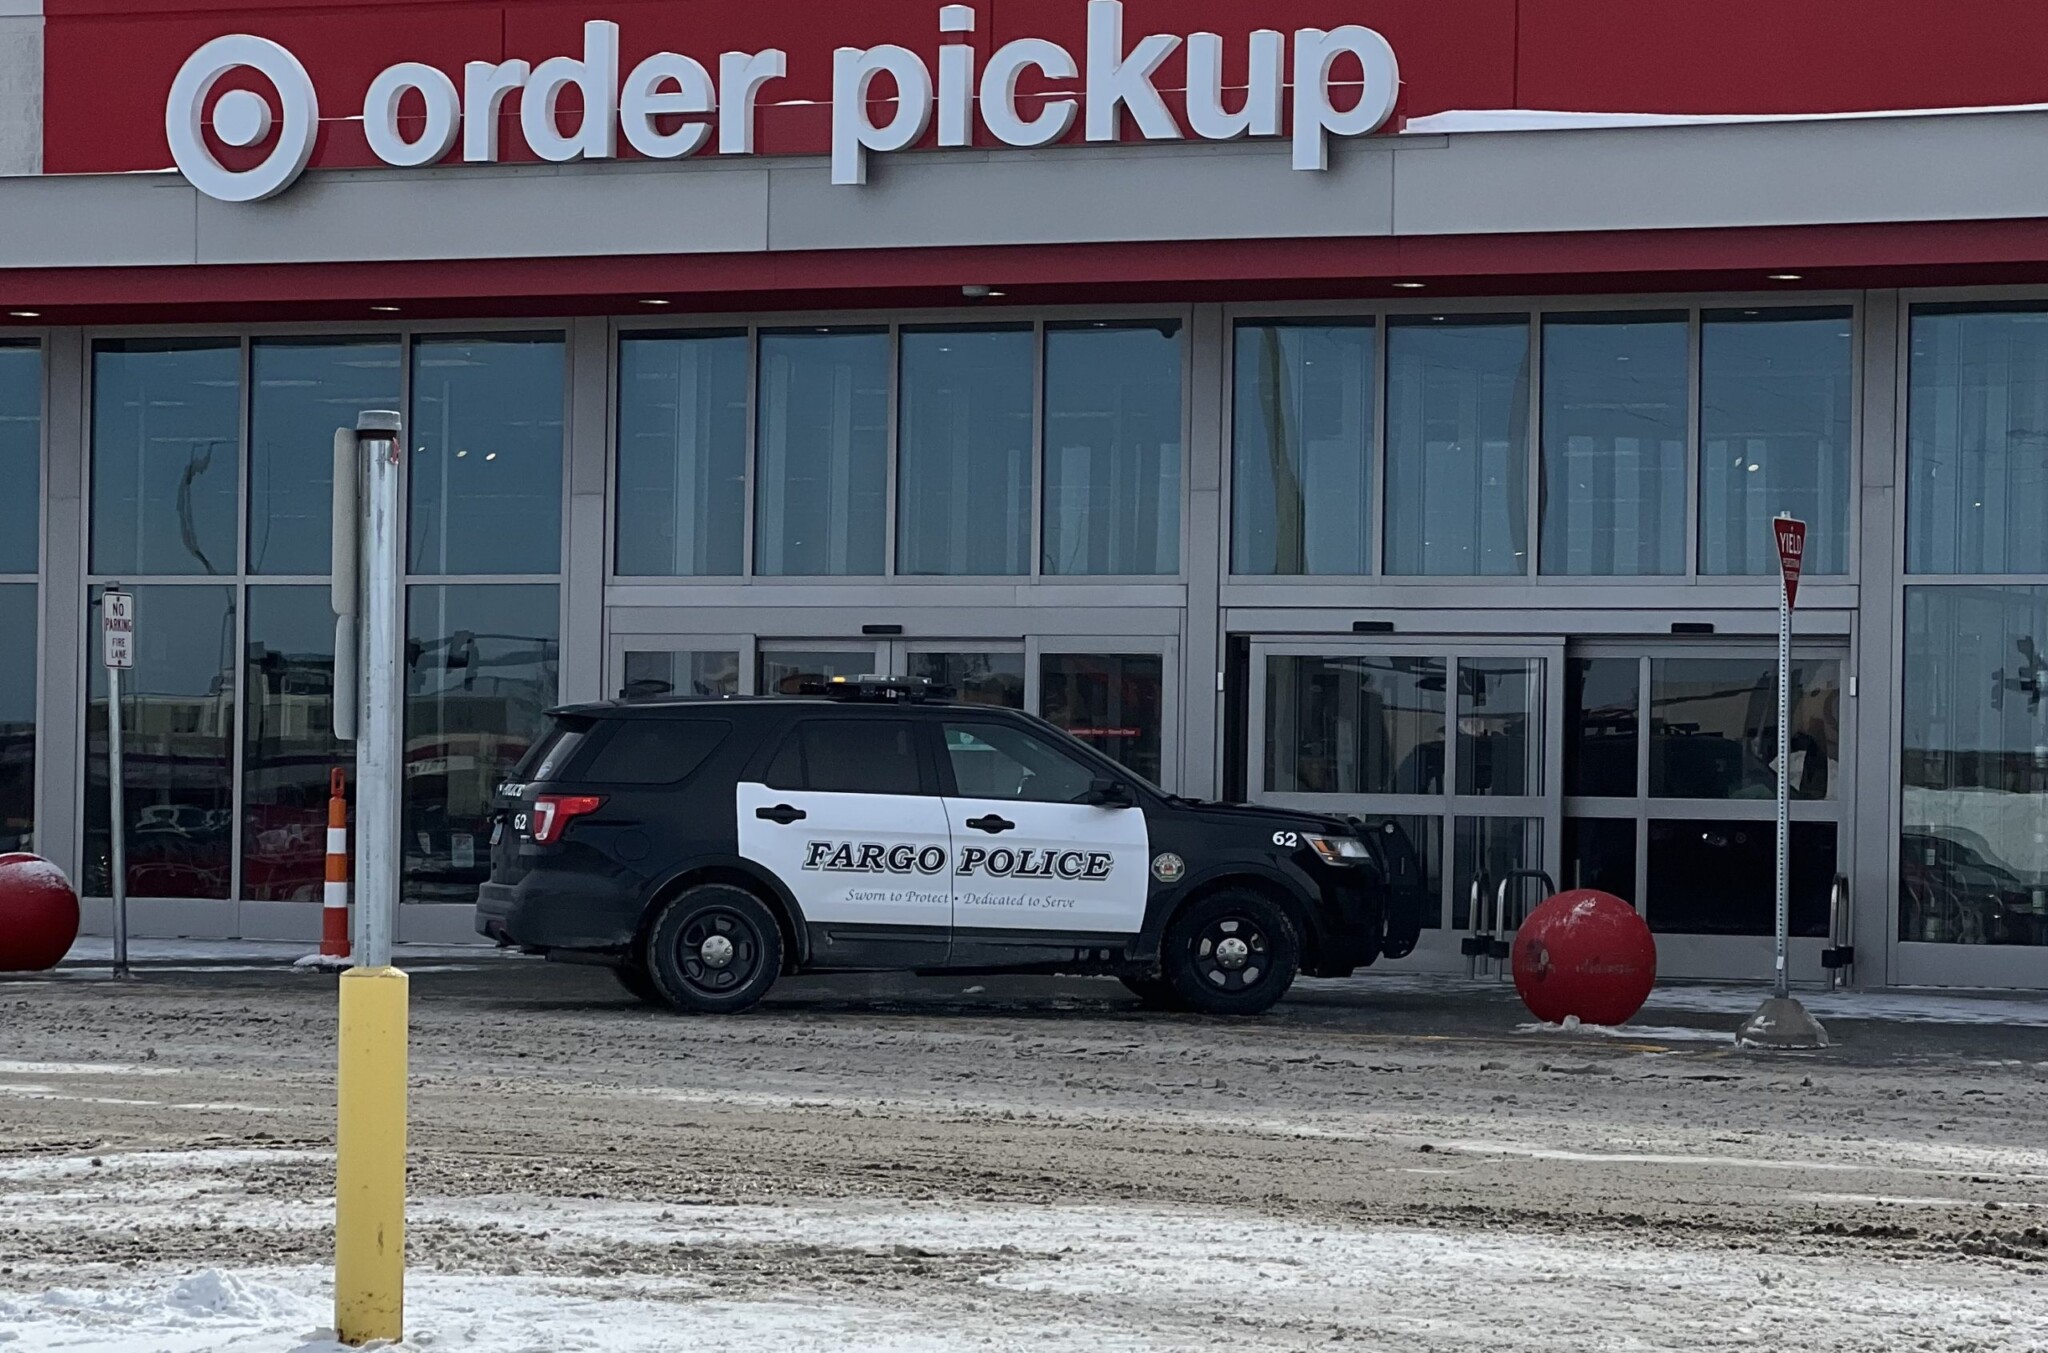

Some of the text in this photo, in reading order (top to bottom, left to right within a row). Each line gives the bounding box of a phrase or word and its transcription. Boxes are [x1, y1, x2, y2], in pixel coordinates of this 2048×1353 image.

[363, 0, 1400, 186] order pickup
[1780, 532, 1801, 555] YIELD
[112, 603, 125, 616] NO
[105, 618, 132, 632] PARKING
[112, 638, 125, 647] FIRE
[111, 649, 126, 659] LANE
[514, 813, 527, 830] 62
[1272, 831, 1298, 848] 62
[803, 840, 1114, 882] FARGO POLICE
[845, 888, 1075, 908] Sworn to Protect Dedicated to Serve
